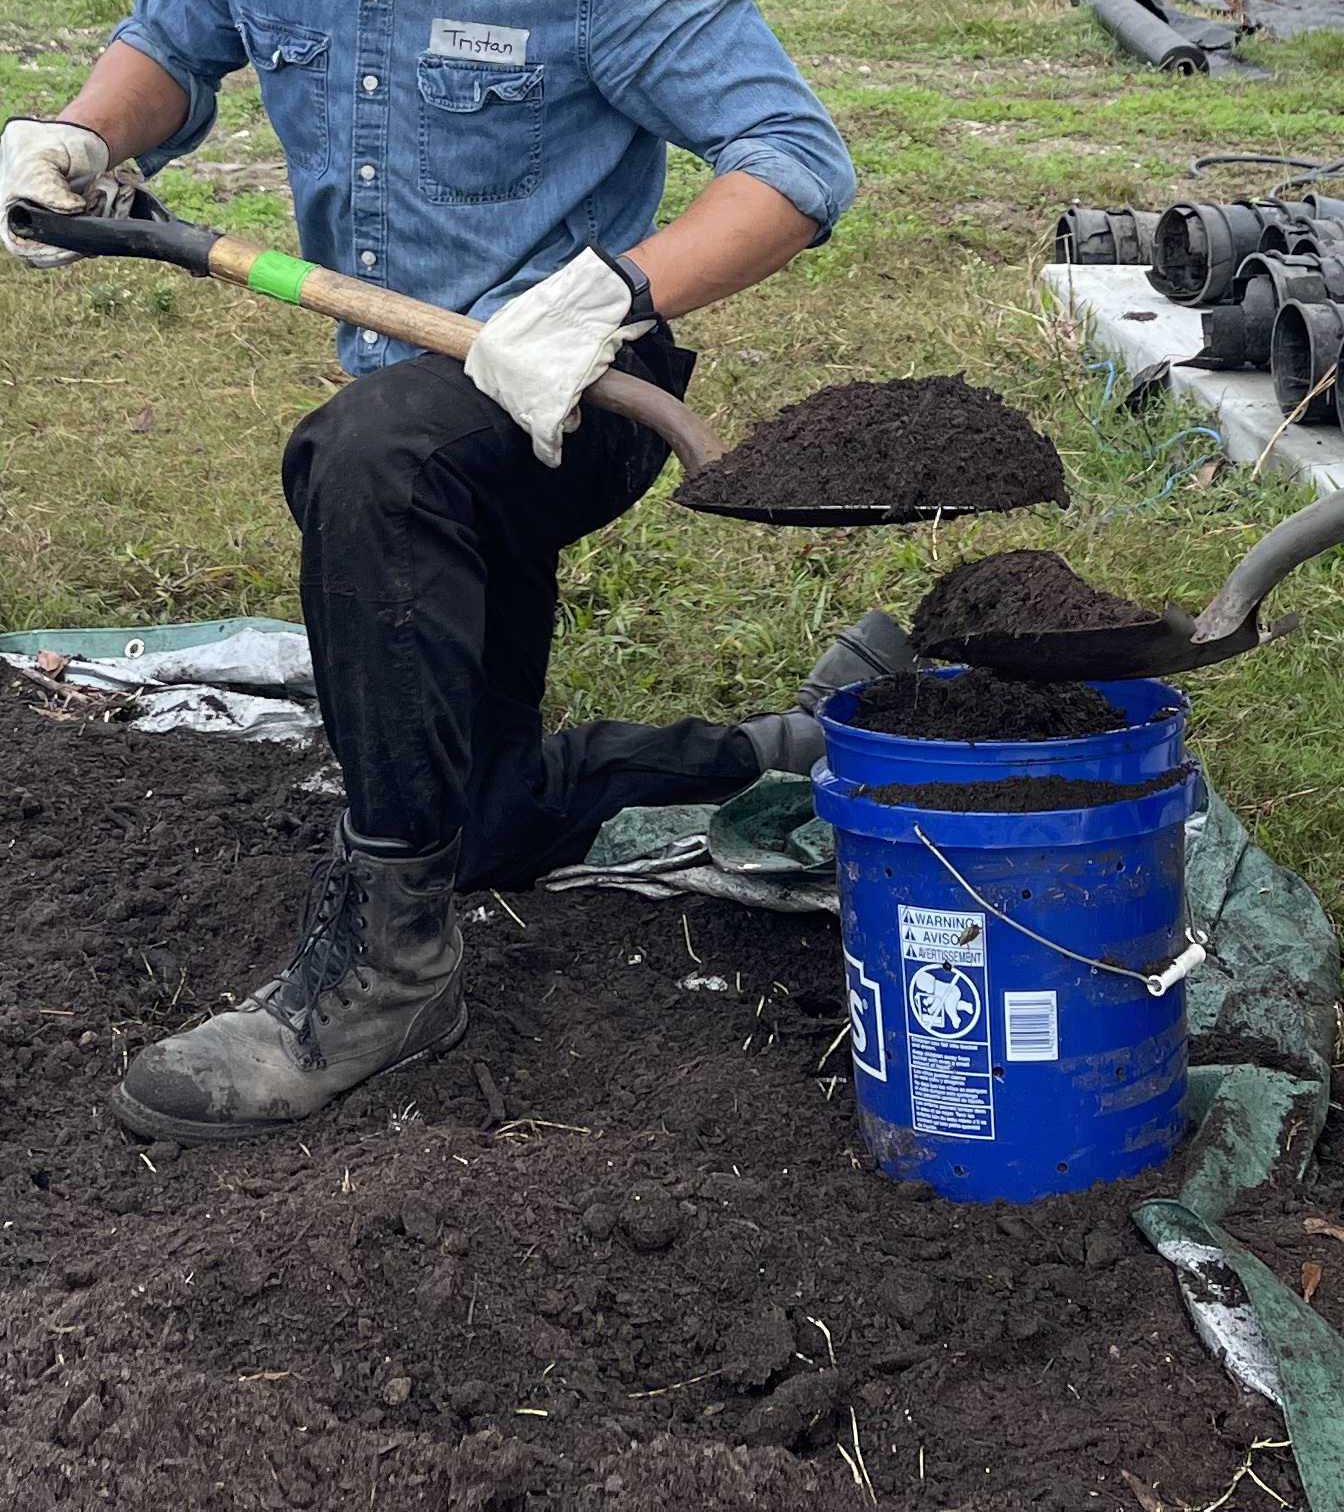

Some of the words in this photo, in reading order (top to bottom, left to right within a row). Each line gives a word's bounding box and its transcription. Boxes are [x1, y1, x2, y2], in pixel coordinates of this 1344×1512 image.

[442, 29, 513, 55] Tristan
[923, 930, 960, 946] AVISO
[918, 946, 982, 965] AVERTISSEMENT
